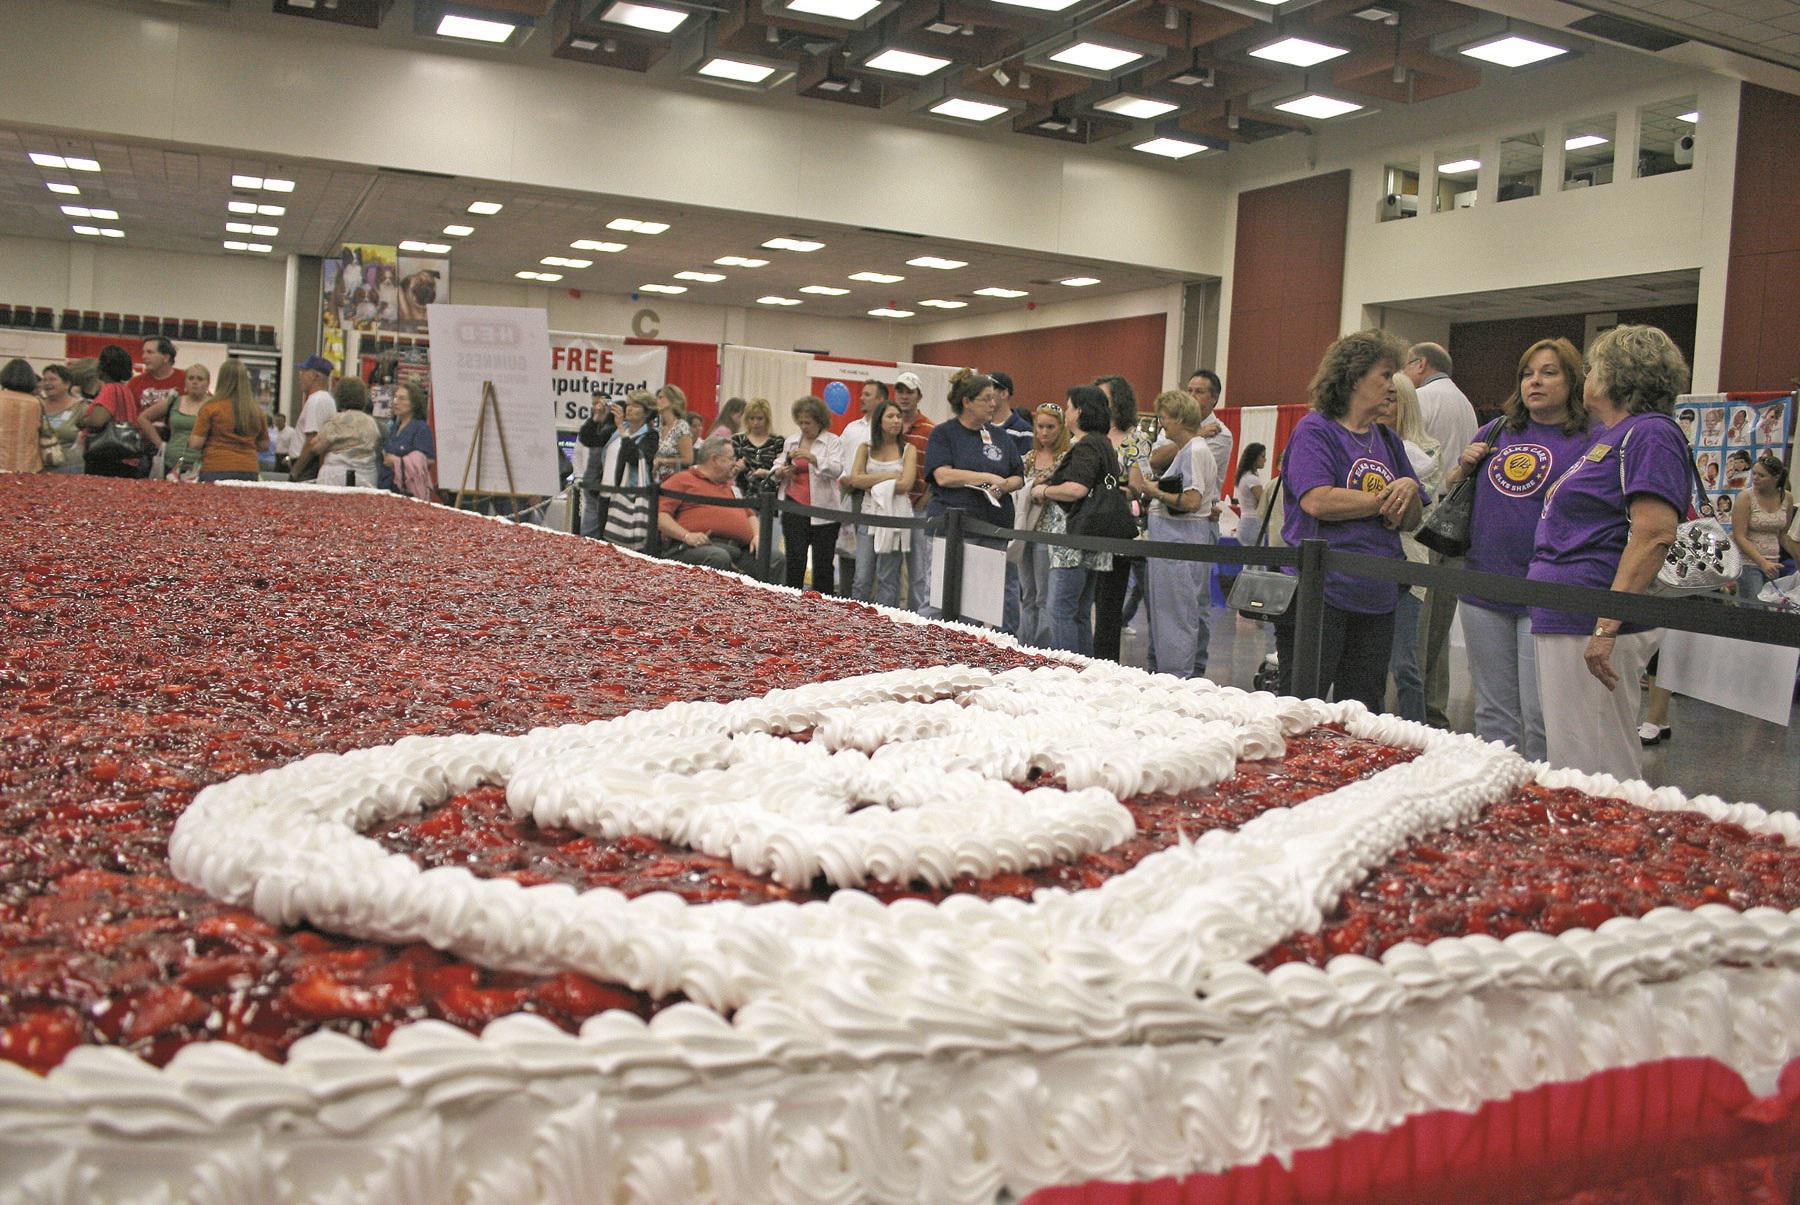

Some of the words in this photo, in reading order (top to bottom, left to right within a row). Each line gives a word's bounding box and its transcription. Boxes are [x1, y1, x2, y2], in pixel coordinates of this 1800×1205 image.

[632, 309, 660, 338] C
[552, 347, 613, 373] FREE
[552, 376, 647, 395] puterized
